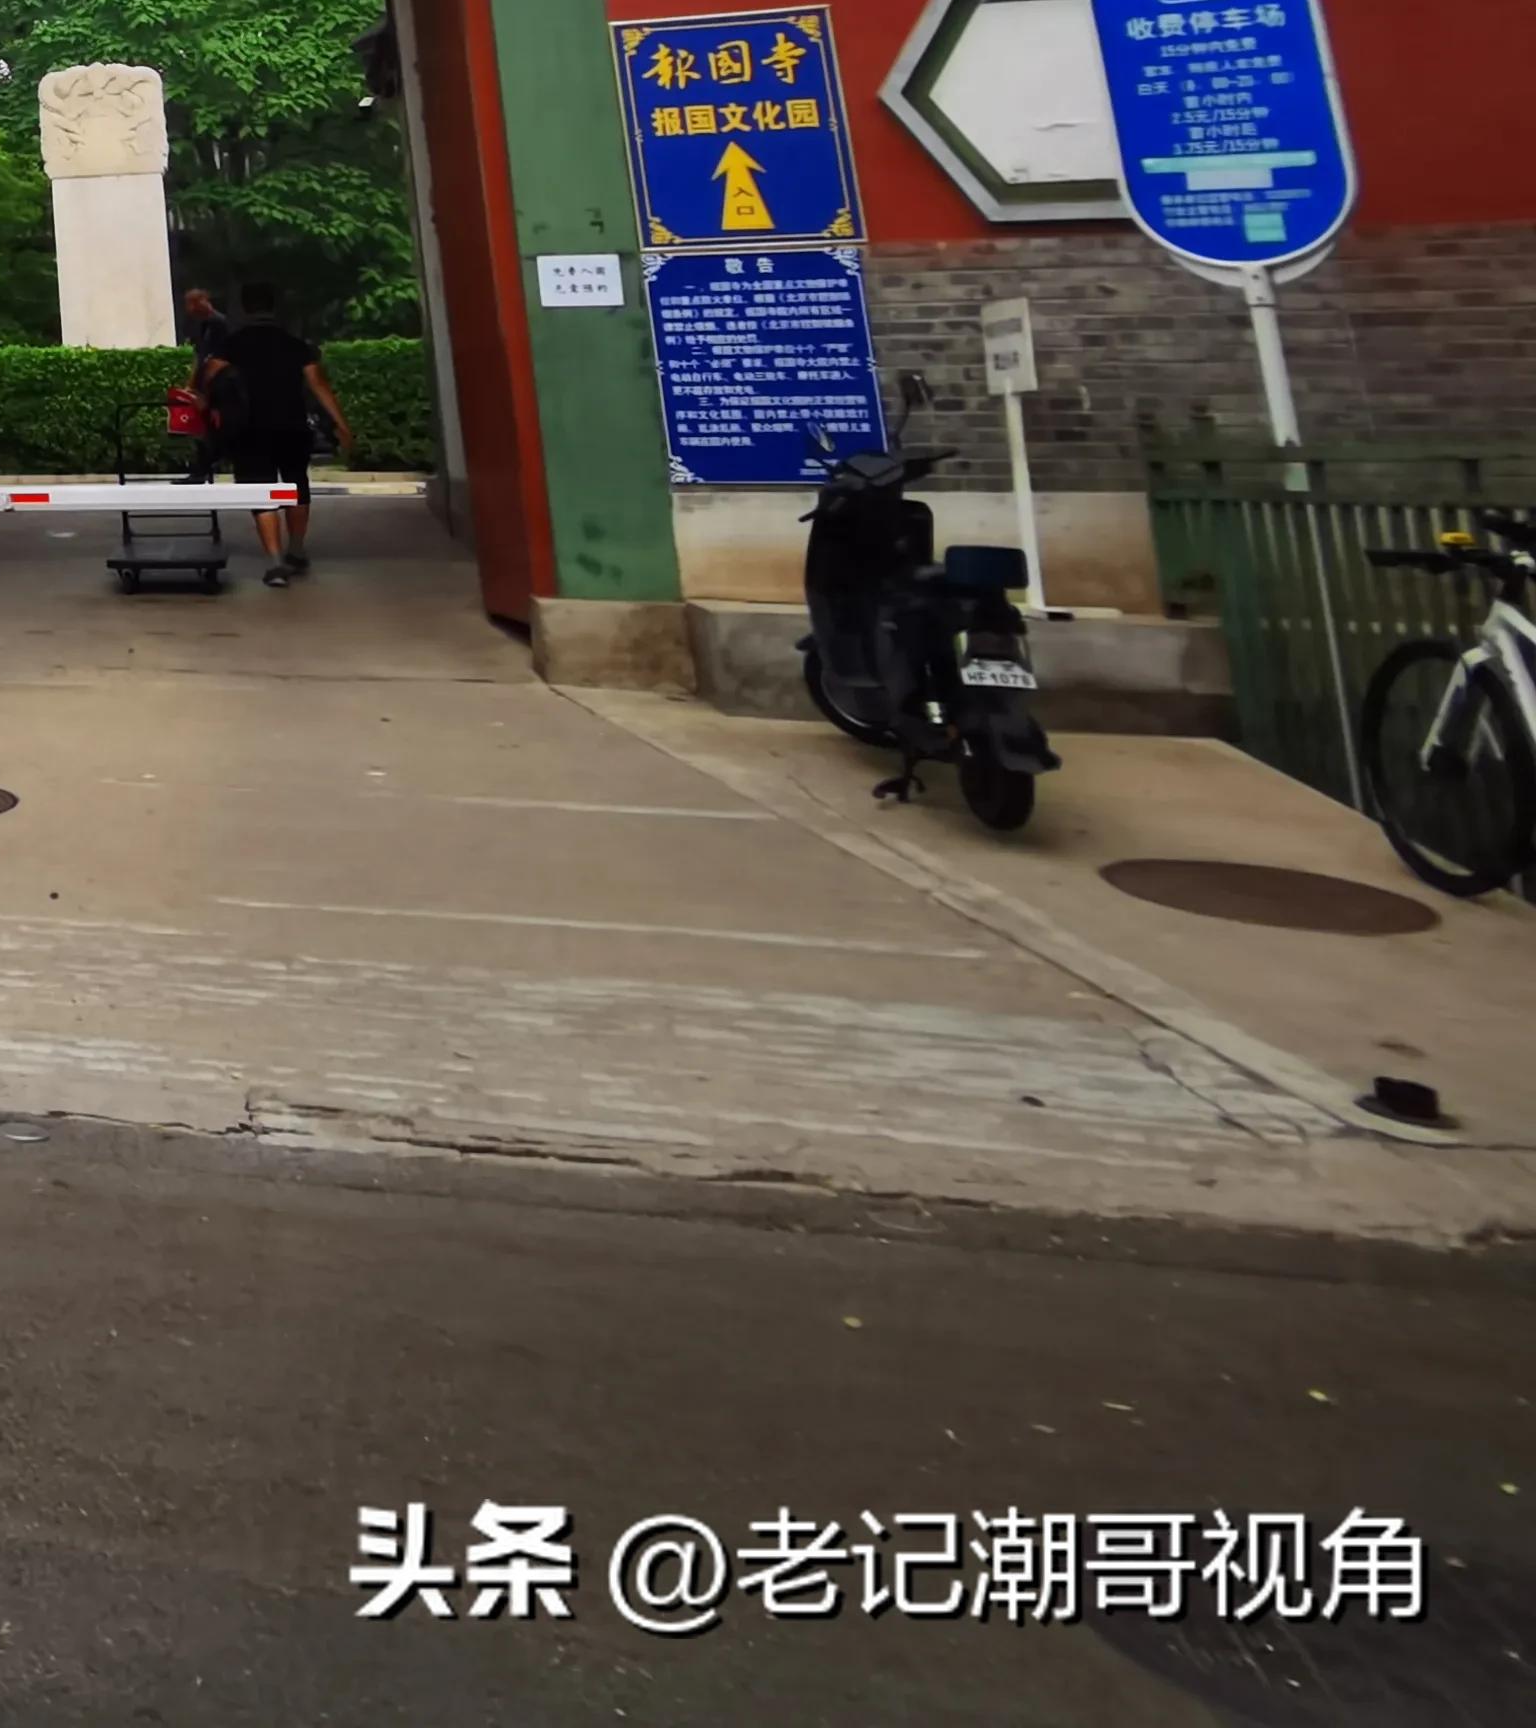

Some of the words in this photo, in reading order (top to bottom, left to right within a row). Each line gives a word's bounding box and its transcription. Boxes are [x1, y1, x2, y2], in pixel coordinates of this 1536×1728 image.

[1126, 4, 1286, 40] 收费停车场
[651, 98, 820, 137] 报国文化园
[733, 186, 755, 216] 入口
